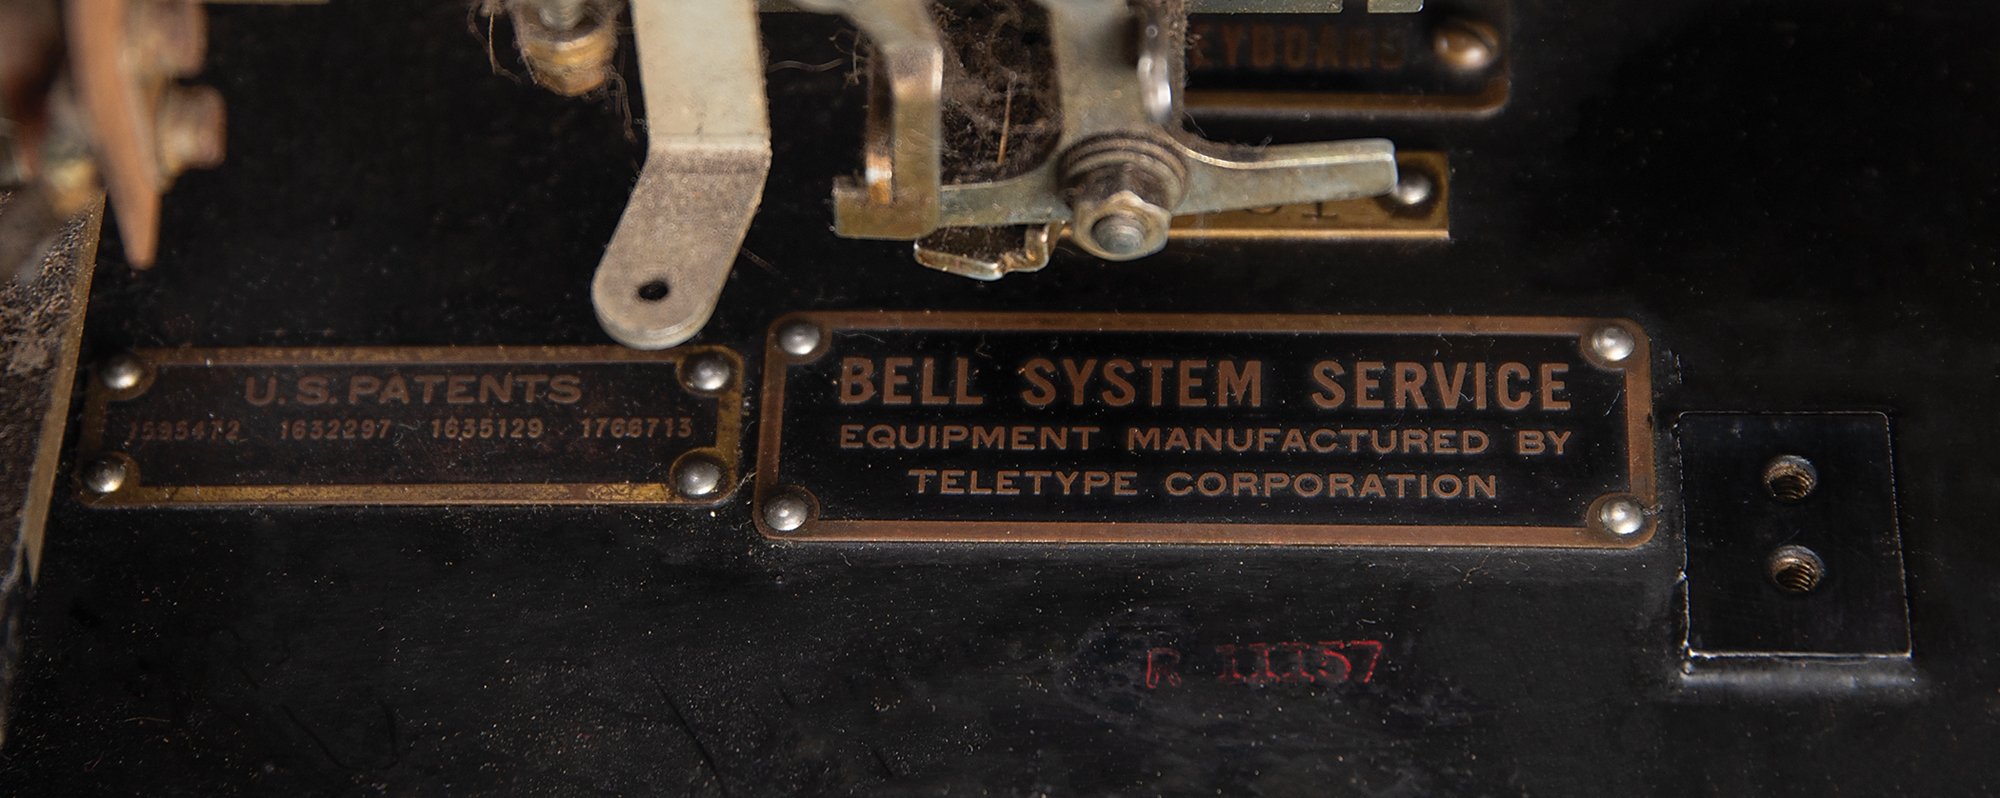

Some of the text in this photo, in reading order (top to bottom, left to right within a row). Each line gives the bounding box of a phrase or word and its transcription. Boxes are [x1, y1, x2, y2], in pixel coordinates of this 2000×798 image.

[839, 356, 1572, 411] BELL SYSTEM SERVICE
[280, 418, 392, 440] 1632297
[431, 417, 544, 440] 1635129
[580, 417, 693, 439] 1766713
[839, 423, 1572, 456] EQUIPMENT MANUFACTURED BY
[907, 468, 1497, 499] TELETYPE CORPORATION
